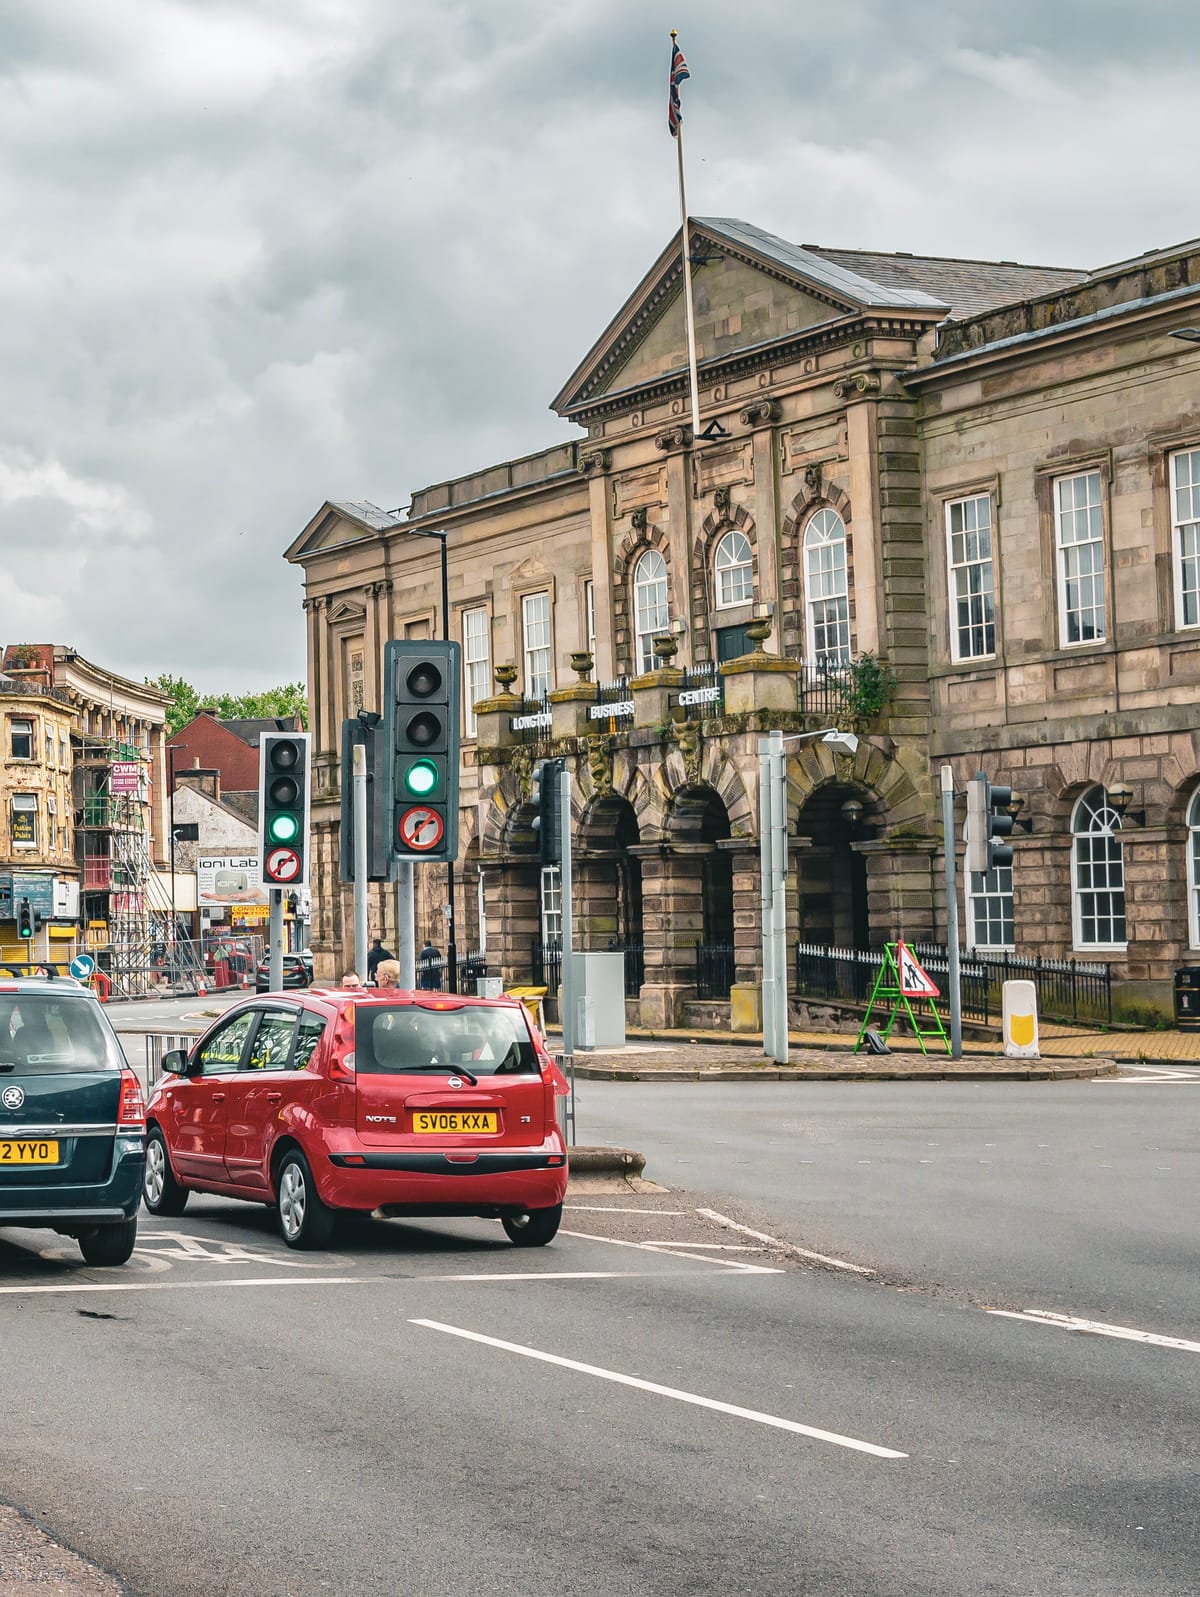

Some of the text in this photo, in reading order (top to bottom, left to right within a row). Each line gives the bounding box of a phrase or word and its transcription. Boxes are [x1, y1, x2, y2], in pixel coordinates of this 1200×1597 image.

[513, 686, 720, 730] LONGTON BUSINESS CENTRE
[113, 764, 137, 773] CWM
[199, 858, 258, 868] ioni Lab
[366, 1115, 397, 1123] NOTE
[420, 1115, 490, 1129] SV06 KXA
[18, 1144, 48, 1159] YYO
